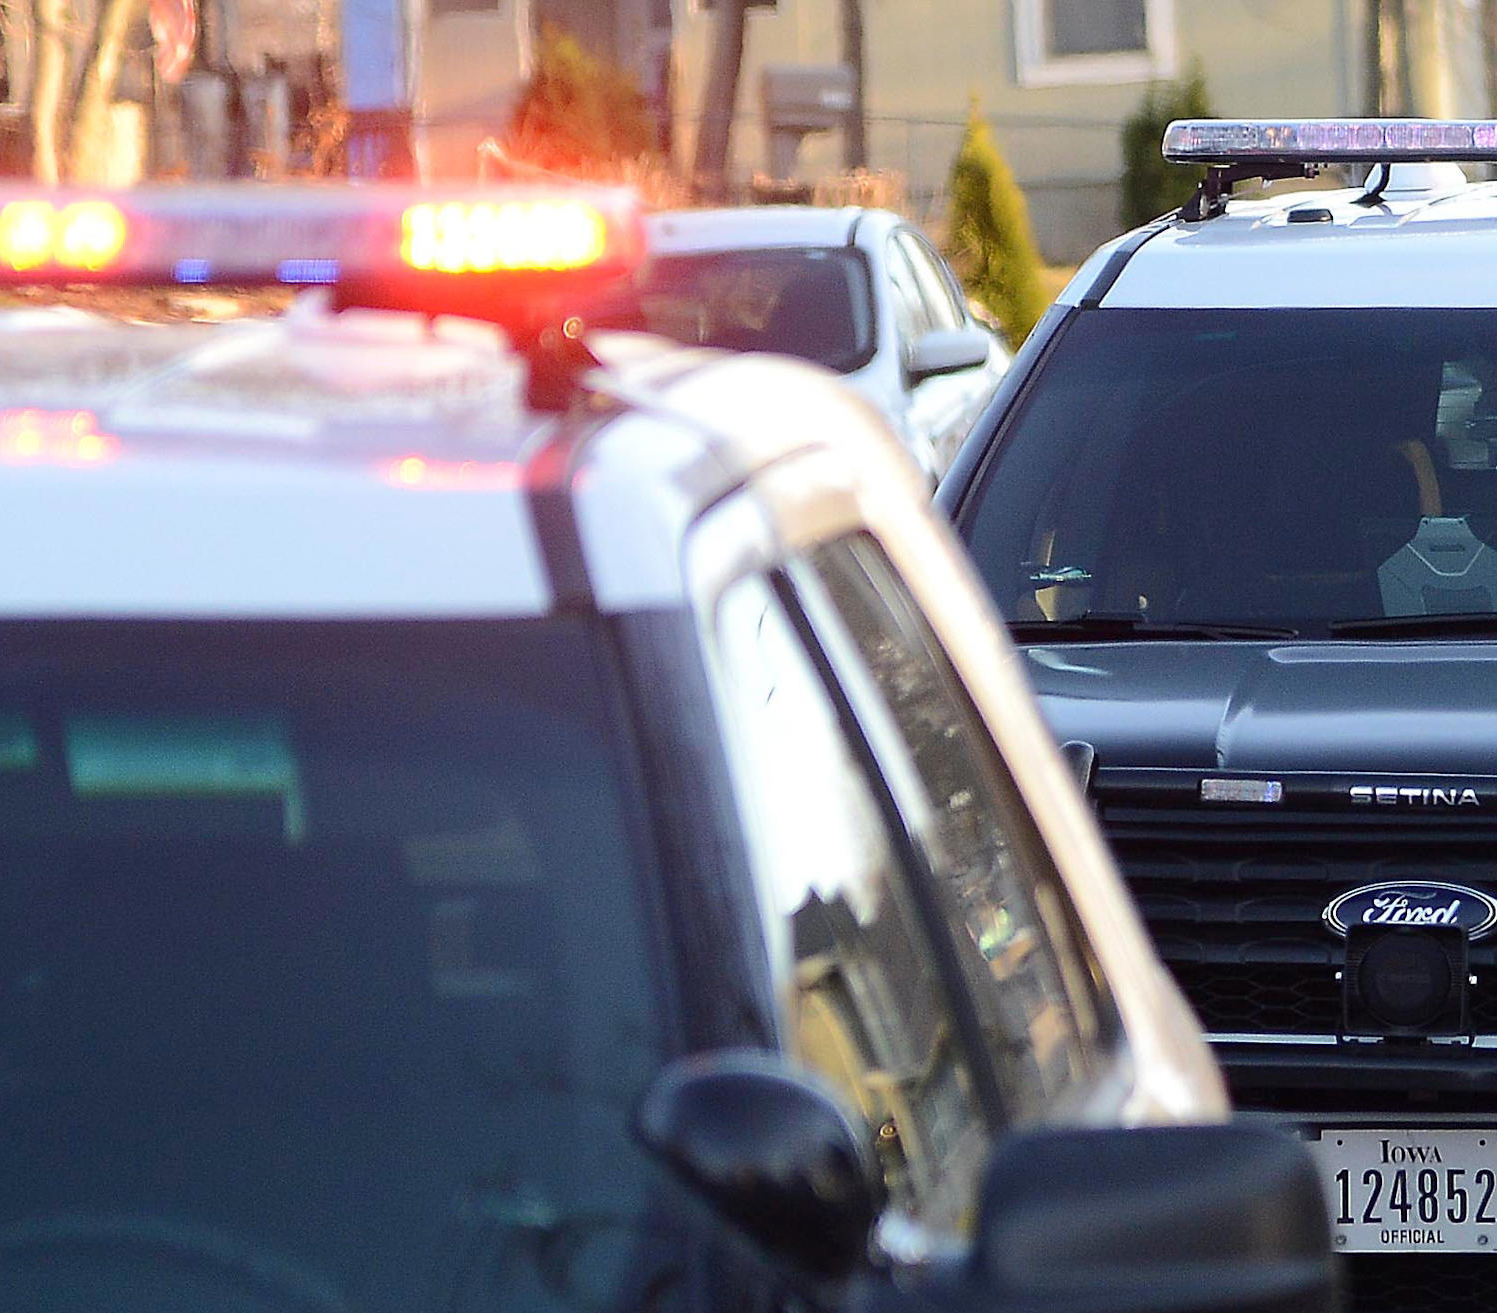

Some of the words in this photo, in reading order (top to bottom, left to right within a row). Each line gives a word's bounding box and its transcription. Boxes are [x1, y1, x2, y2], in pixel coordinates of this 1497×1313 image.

[1349, 786, 1480, 806] SETINA
[1362, 895, 1461, 925] Ford
[1335, 1168, 1497, 1224] 124852
[1380, 1229, 1445, 1244] OFFICIAL
